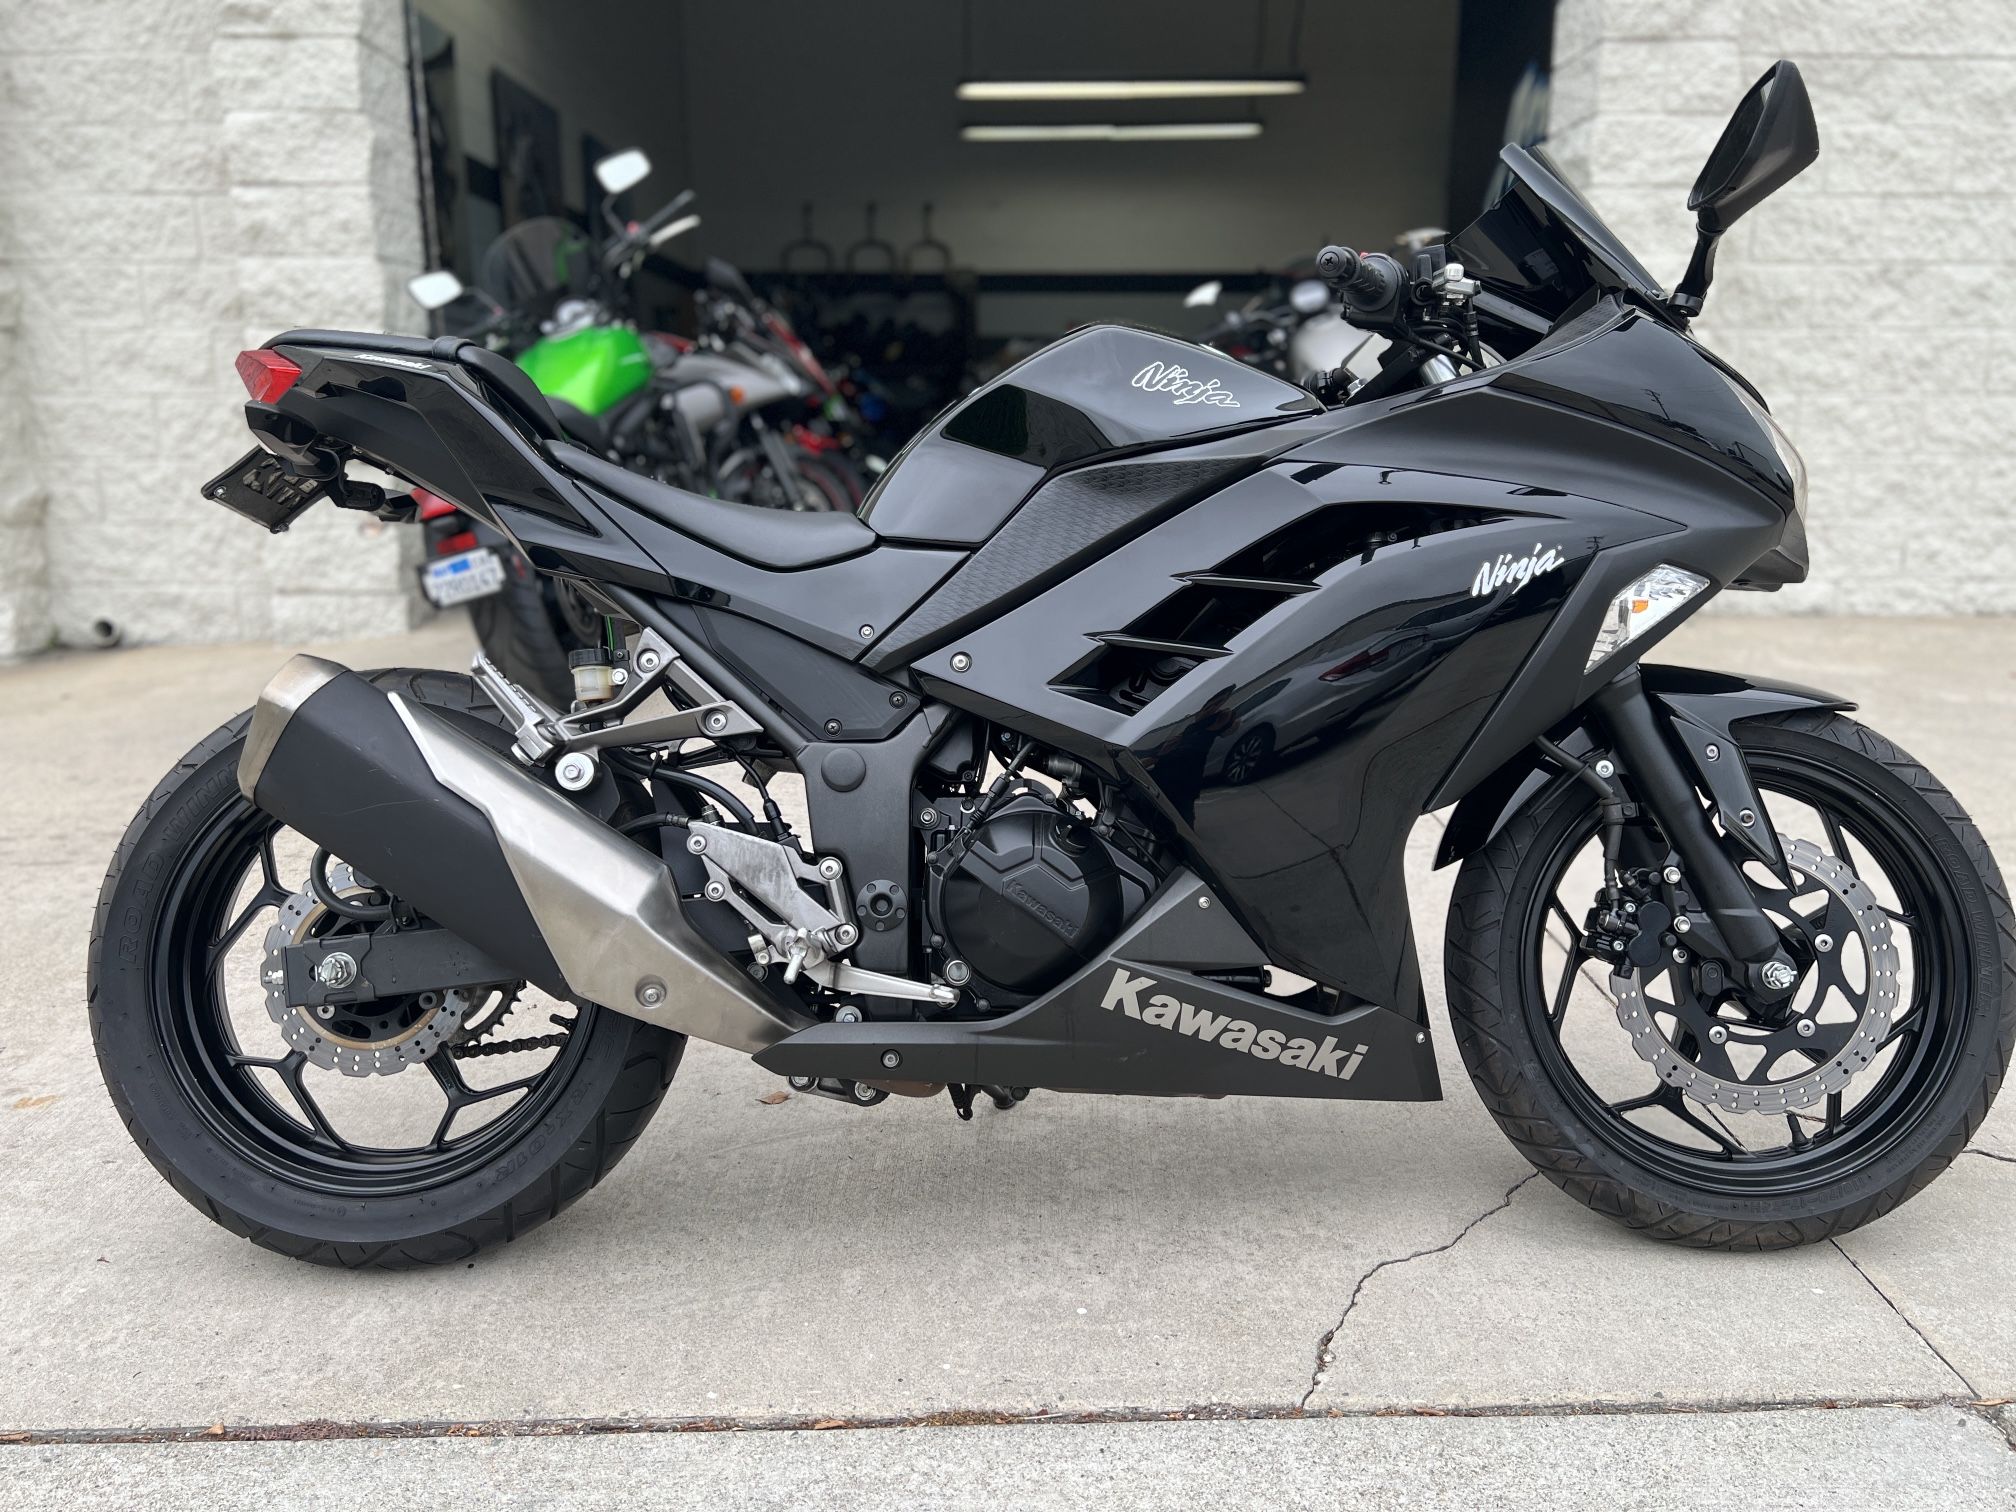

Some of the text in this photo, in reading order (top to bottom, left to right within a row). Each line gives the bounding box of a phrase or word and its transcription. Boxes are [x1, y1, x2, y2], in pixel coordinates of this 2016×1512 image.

[1132, 361, 1240, 407] Ninja
[1471, 542, 1565, 597] Ninja
[119, 760, 240, 964] ROAD WINN
[1004, 878, 1080, 940] Kawasaki
[1930, 833, 1994, 1012] ROAD WINNER
[1100, 967, 1369, 1081] Kawasaki
